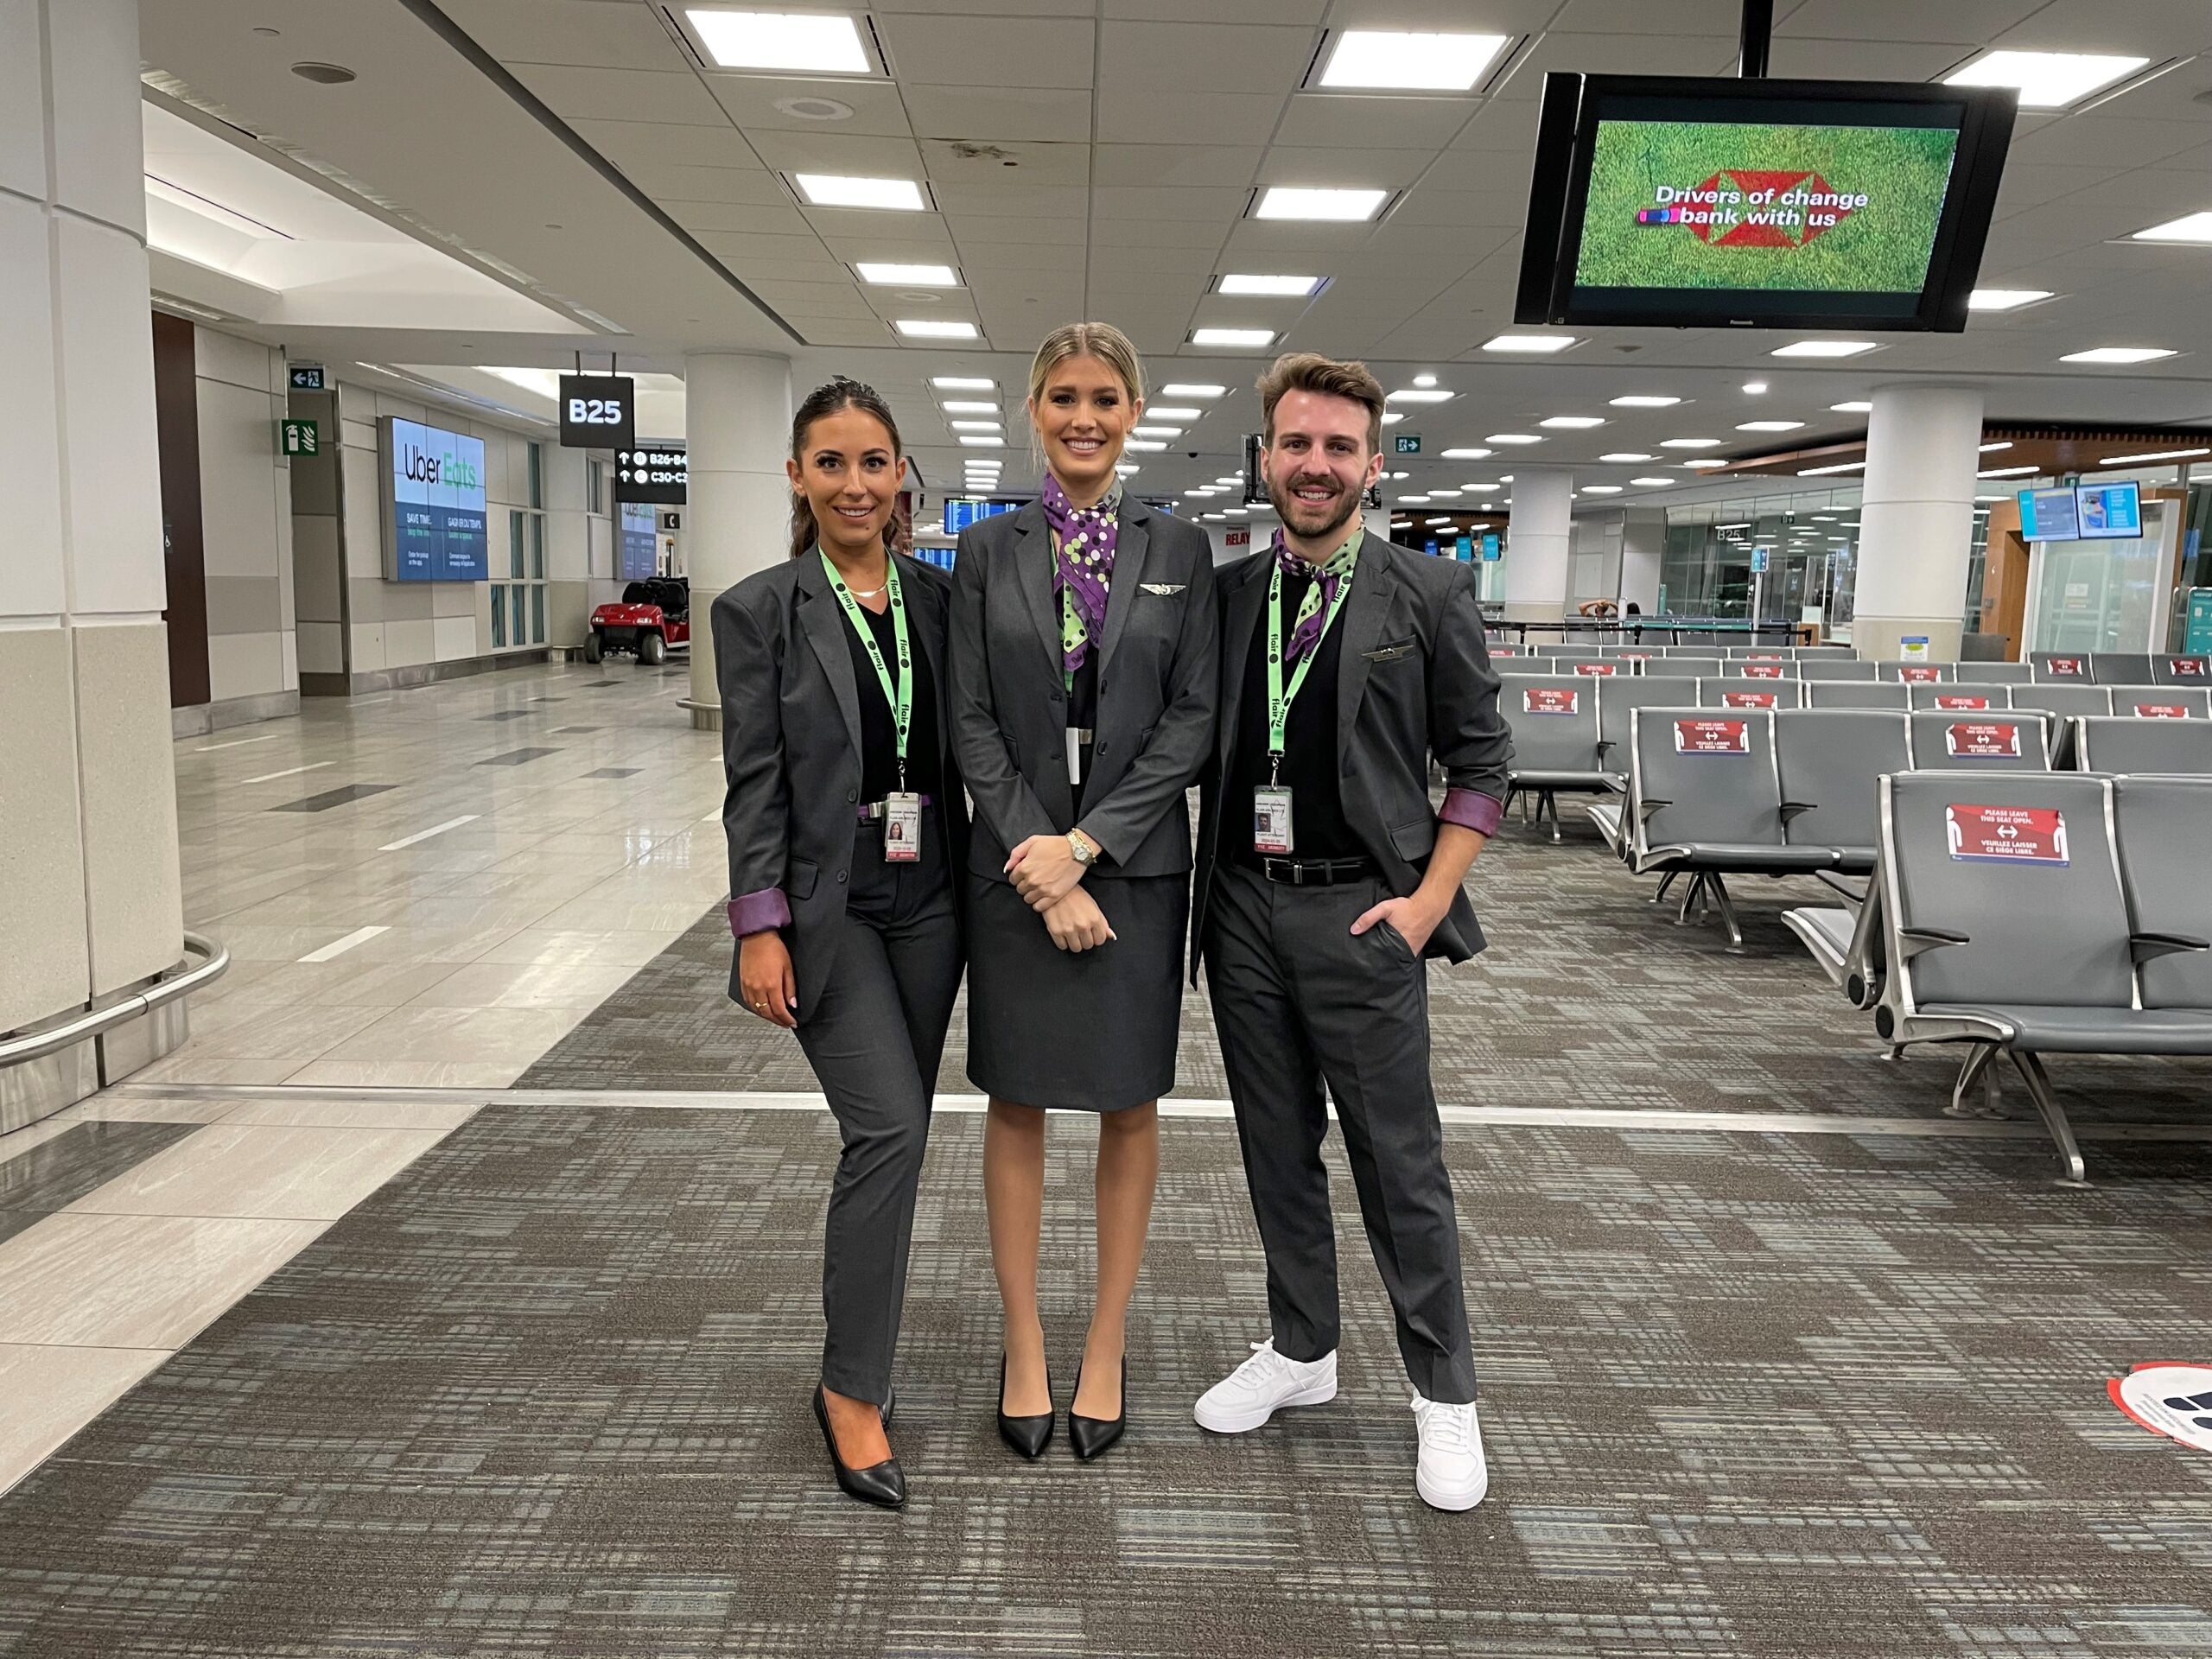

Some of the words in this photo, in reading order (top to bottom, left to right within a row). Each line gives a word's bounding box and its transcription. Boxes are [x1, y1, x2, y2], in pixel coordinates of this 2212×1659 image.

[1656, 186, 1740, 204] Drivers
[1748, 189, 1774, 205] of
[1781, 189, 1868, 210] change
[1679, 207, 1738, 224] bank
[1747, 209, 1800, 226] with
[1808, 213, 1836, 226] us
[569, 398, 621, 424] B25
[404, 442, 441, 485] Uber
[443, 451, 476, 490] Eats
[406, 512, 419, 524] SAVE
[890, 579, 899, 597] flair
[1332, 584, 1346, 603] flair
[842, 592, 855, 610] flair
[899, 639, 908, 658] flair
[1270, 633, 1279, 652] flair
[873, 652, 884, 671] flair
[900, 703, 910, 724] flair
[1275, 709, 1286, 728] flair
